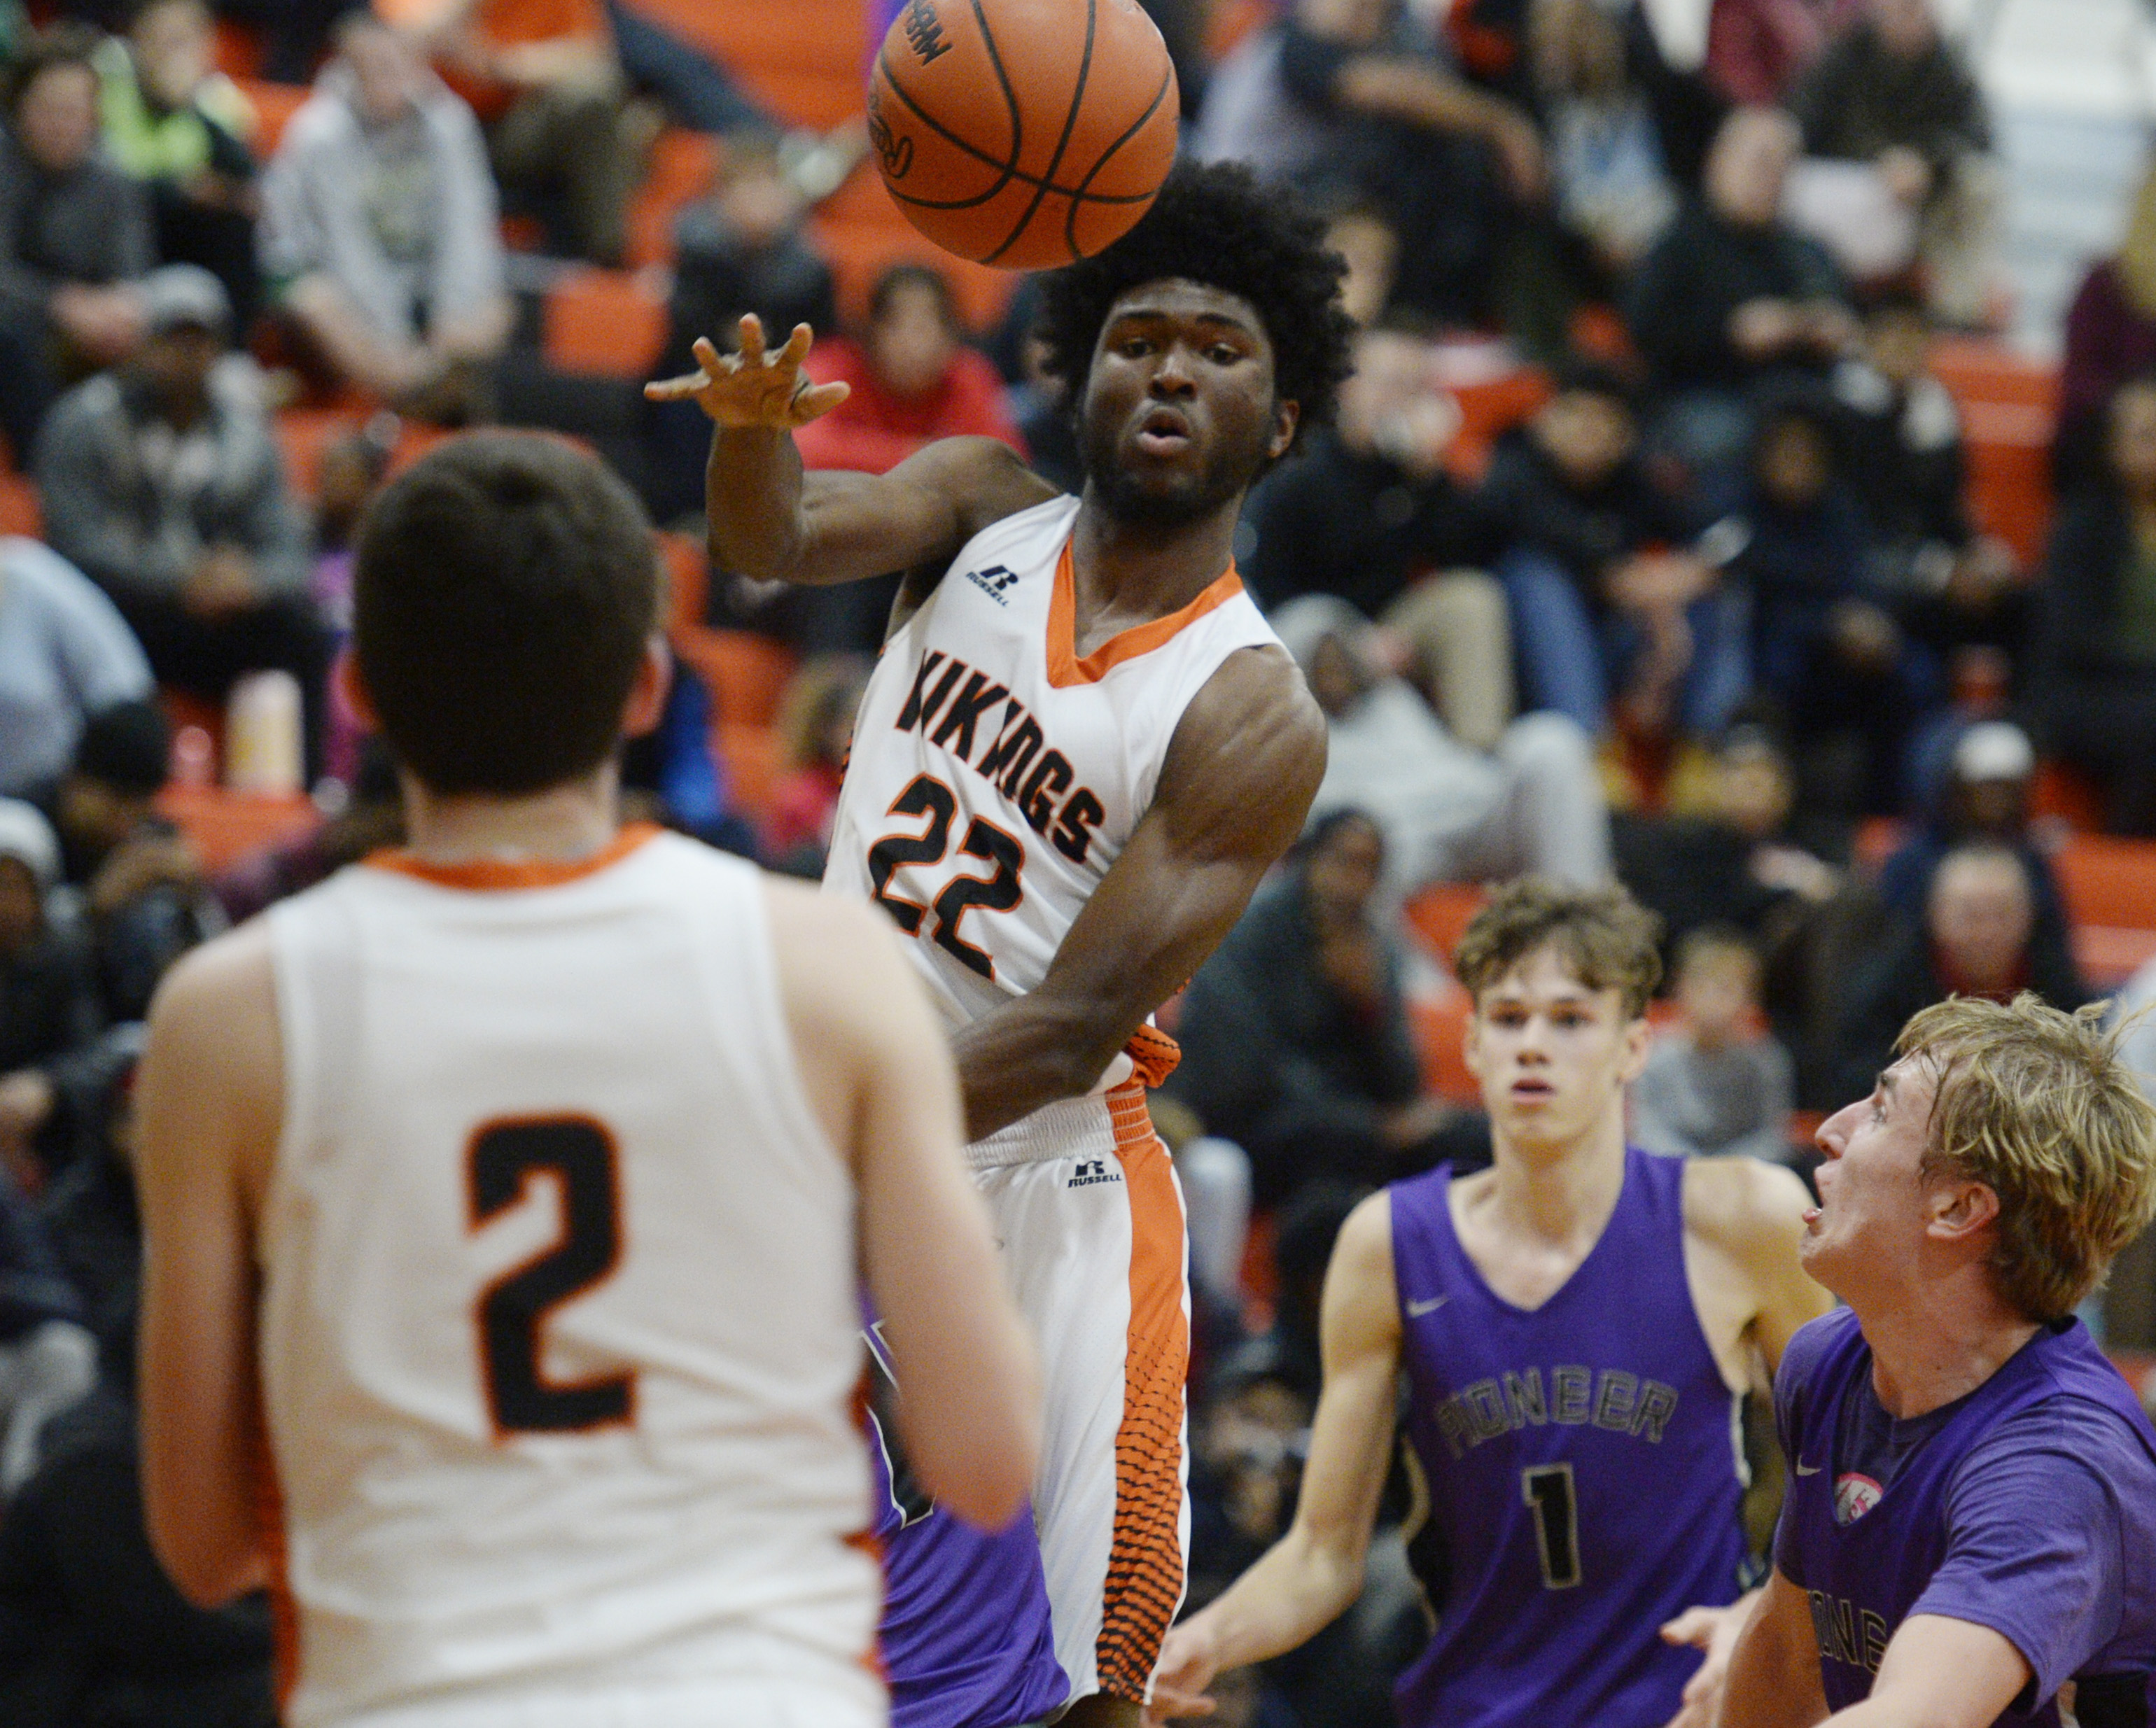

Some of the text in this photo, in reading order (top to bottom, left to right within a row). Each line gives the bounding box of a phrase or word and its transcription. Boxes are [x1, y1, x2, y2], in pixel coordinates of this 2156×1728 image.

[966, 571, 1009, 607] RUSSELL
[868, 771, 1026, 982] 22
[1068, 1174, 1122, 1188] RUSSELL
[462, 1111, 638, 1445] 2
[1435, 1364, 1679, 1460] PIONEER
[1520, 1462, 1582, 1590] 1
